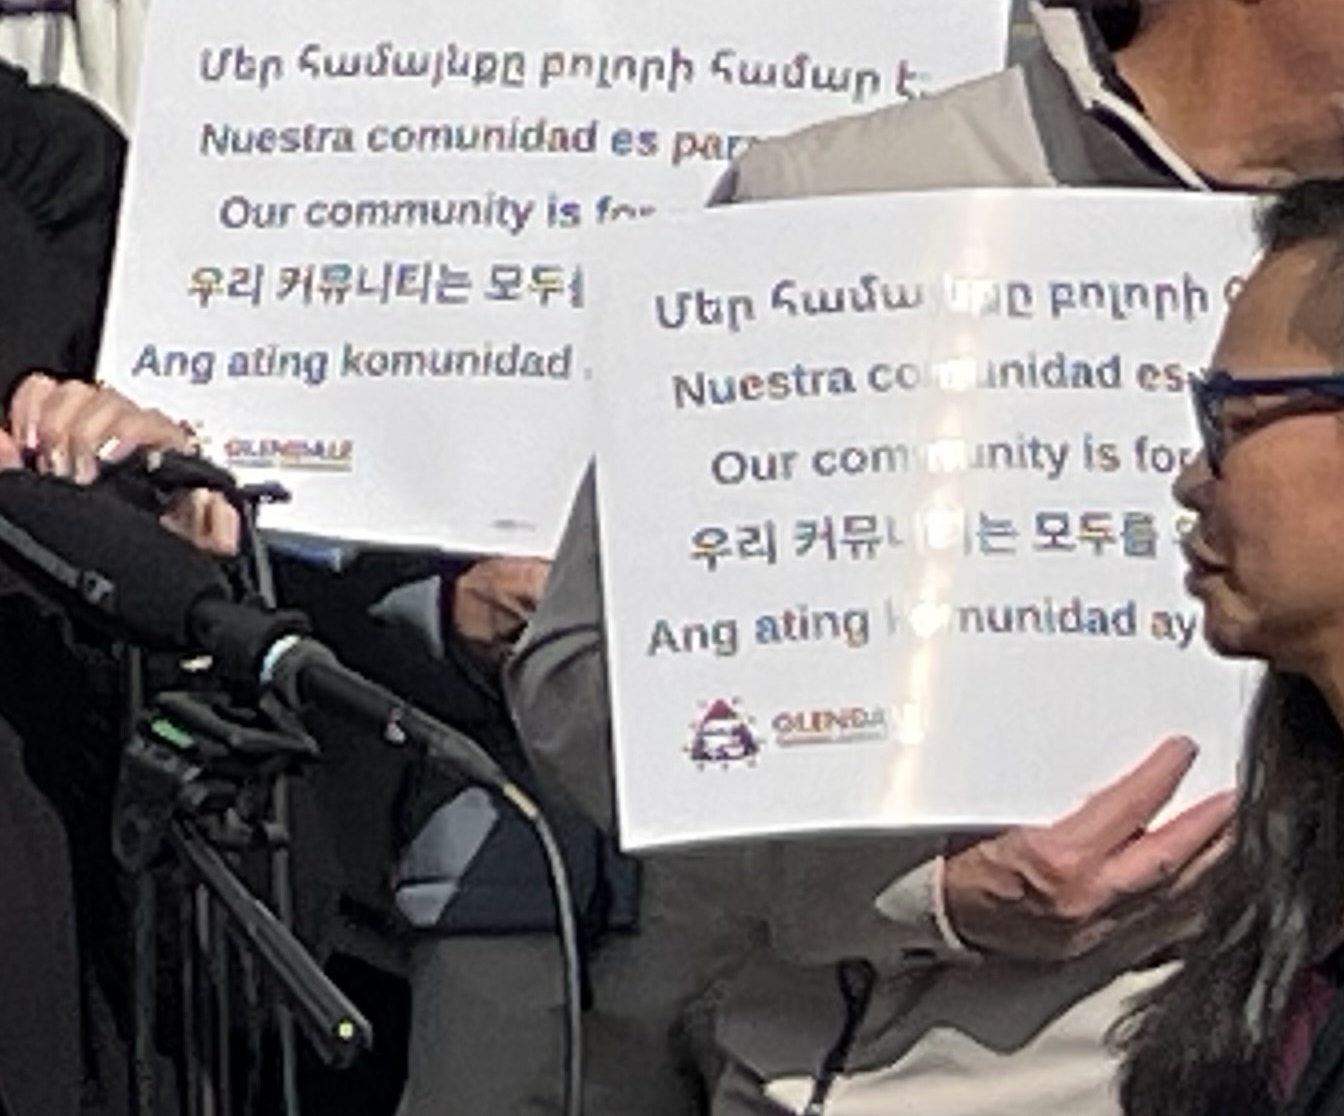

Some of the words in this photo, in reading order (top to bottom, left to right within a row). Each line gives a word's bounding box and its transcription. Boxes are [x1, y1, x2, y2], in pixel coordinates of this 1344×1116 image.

[199, 122, 357, 157] Nuestra
[366, 116, 599, 154] comunidad
[610, 127, 660, 158] es
[671, 127, 753, 168] par
[219, 194, 297, 230] Our
[303, 191, 536, 237] community
[546, 192, 582, 229] is
[187, 263, 265, 309] 우리
[275, 260, 473, 306] 커뮤니티는
[131, 343, 217, 386] Ang
[226, 343, 329, 388] ating
[339, 342, 573, 380] komunidad
[671, 363, 857, 410] Nuestra
[866, 353, 1122, 393] counidad
[1136, 357, 1187, 393] es
[710, 450, 799, 486] Our
[812, 437, 1070, 480] comunity
[1083, 432, 1122, 473] is
[1133, 433, 1193, 474] for
[690, 519, 778, 573] 우리
[1033, 511, 1159, 560] 모두를
[647, 619, 739, 658] Ang
[754, 604, 870, 649] ating
[1151, 606, 1199, 651] ay
